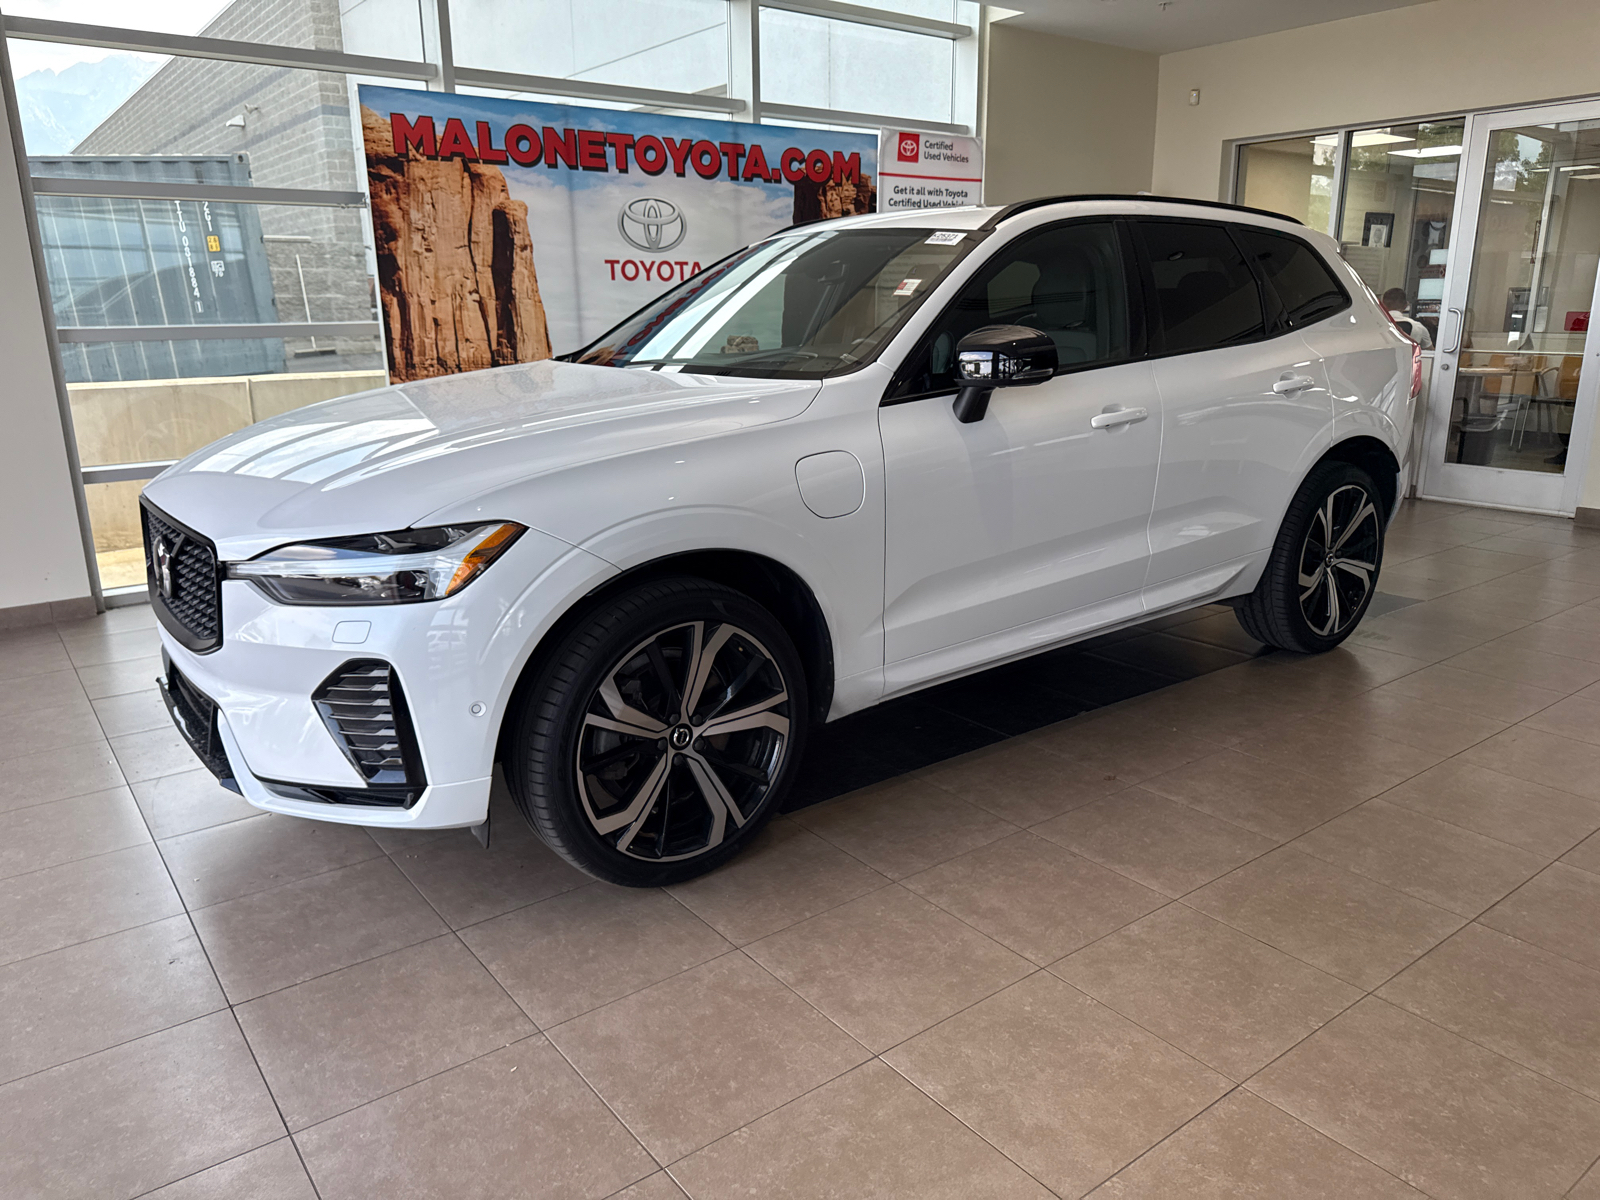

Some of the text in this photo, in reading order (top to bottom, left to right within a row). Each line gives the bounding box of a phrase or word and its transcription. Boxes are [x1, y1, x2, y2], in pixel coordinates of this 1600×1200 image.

[390, 112, 861, 185] MALONETOYOTA.COM
[924, 140, 954, 151] Certified
[923, 151, 969, 163] Used Vehicles
[893, 185, 968, 199] Get it all with Toyota
[888, 198, 921, 208] Certified
